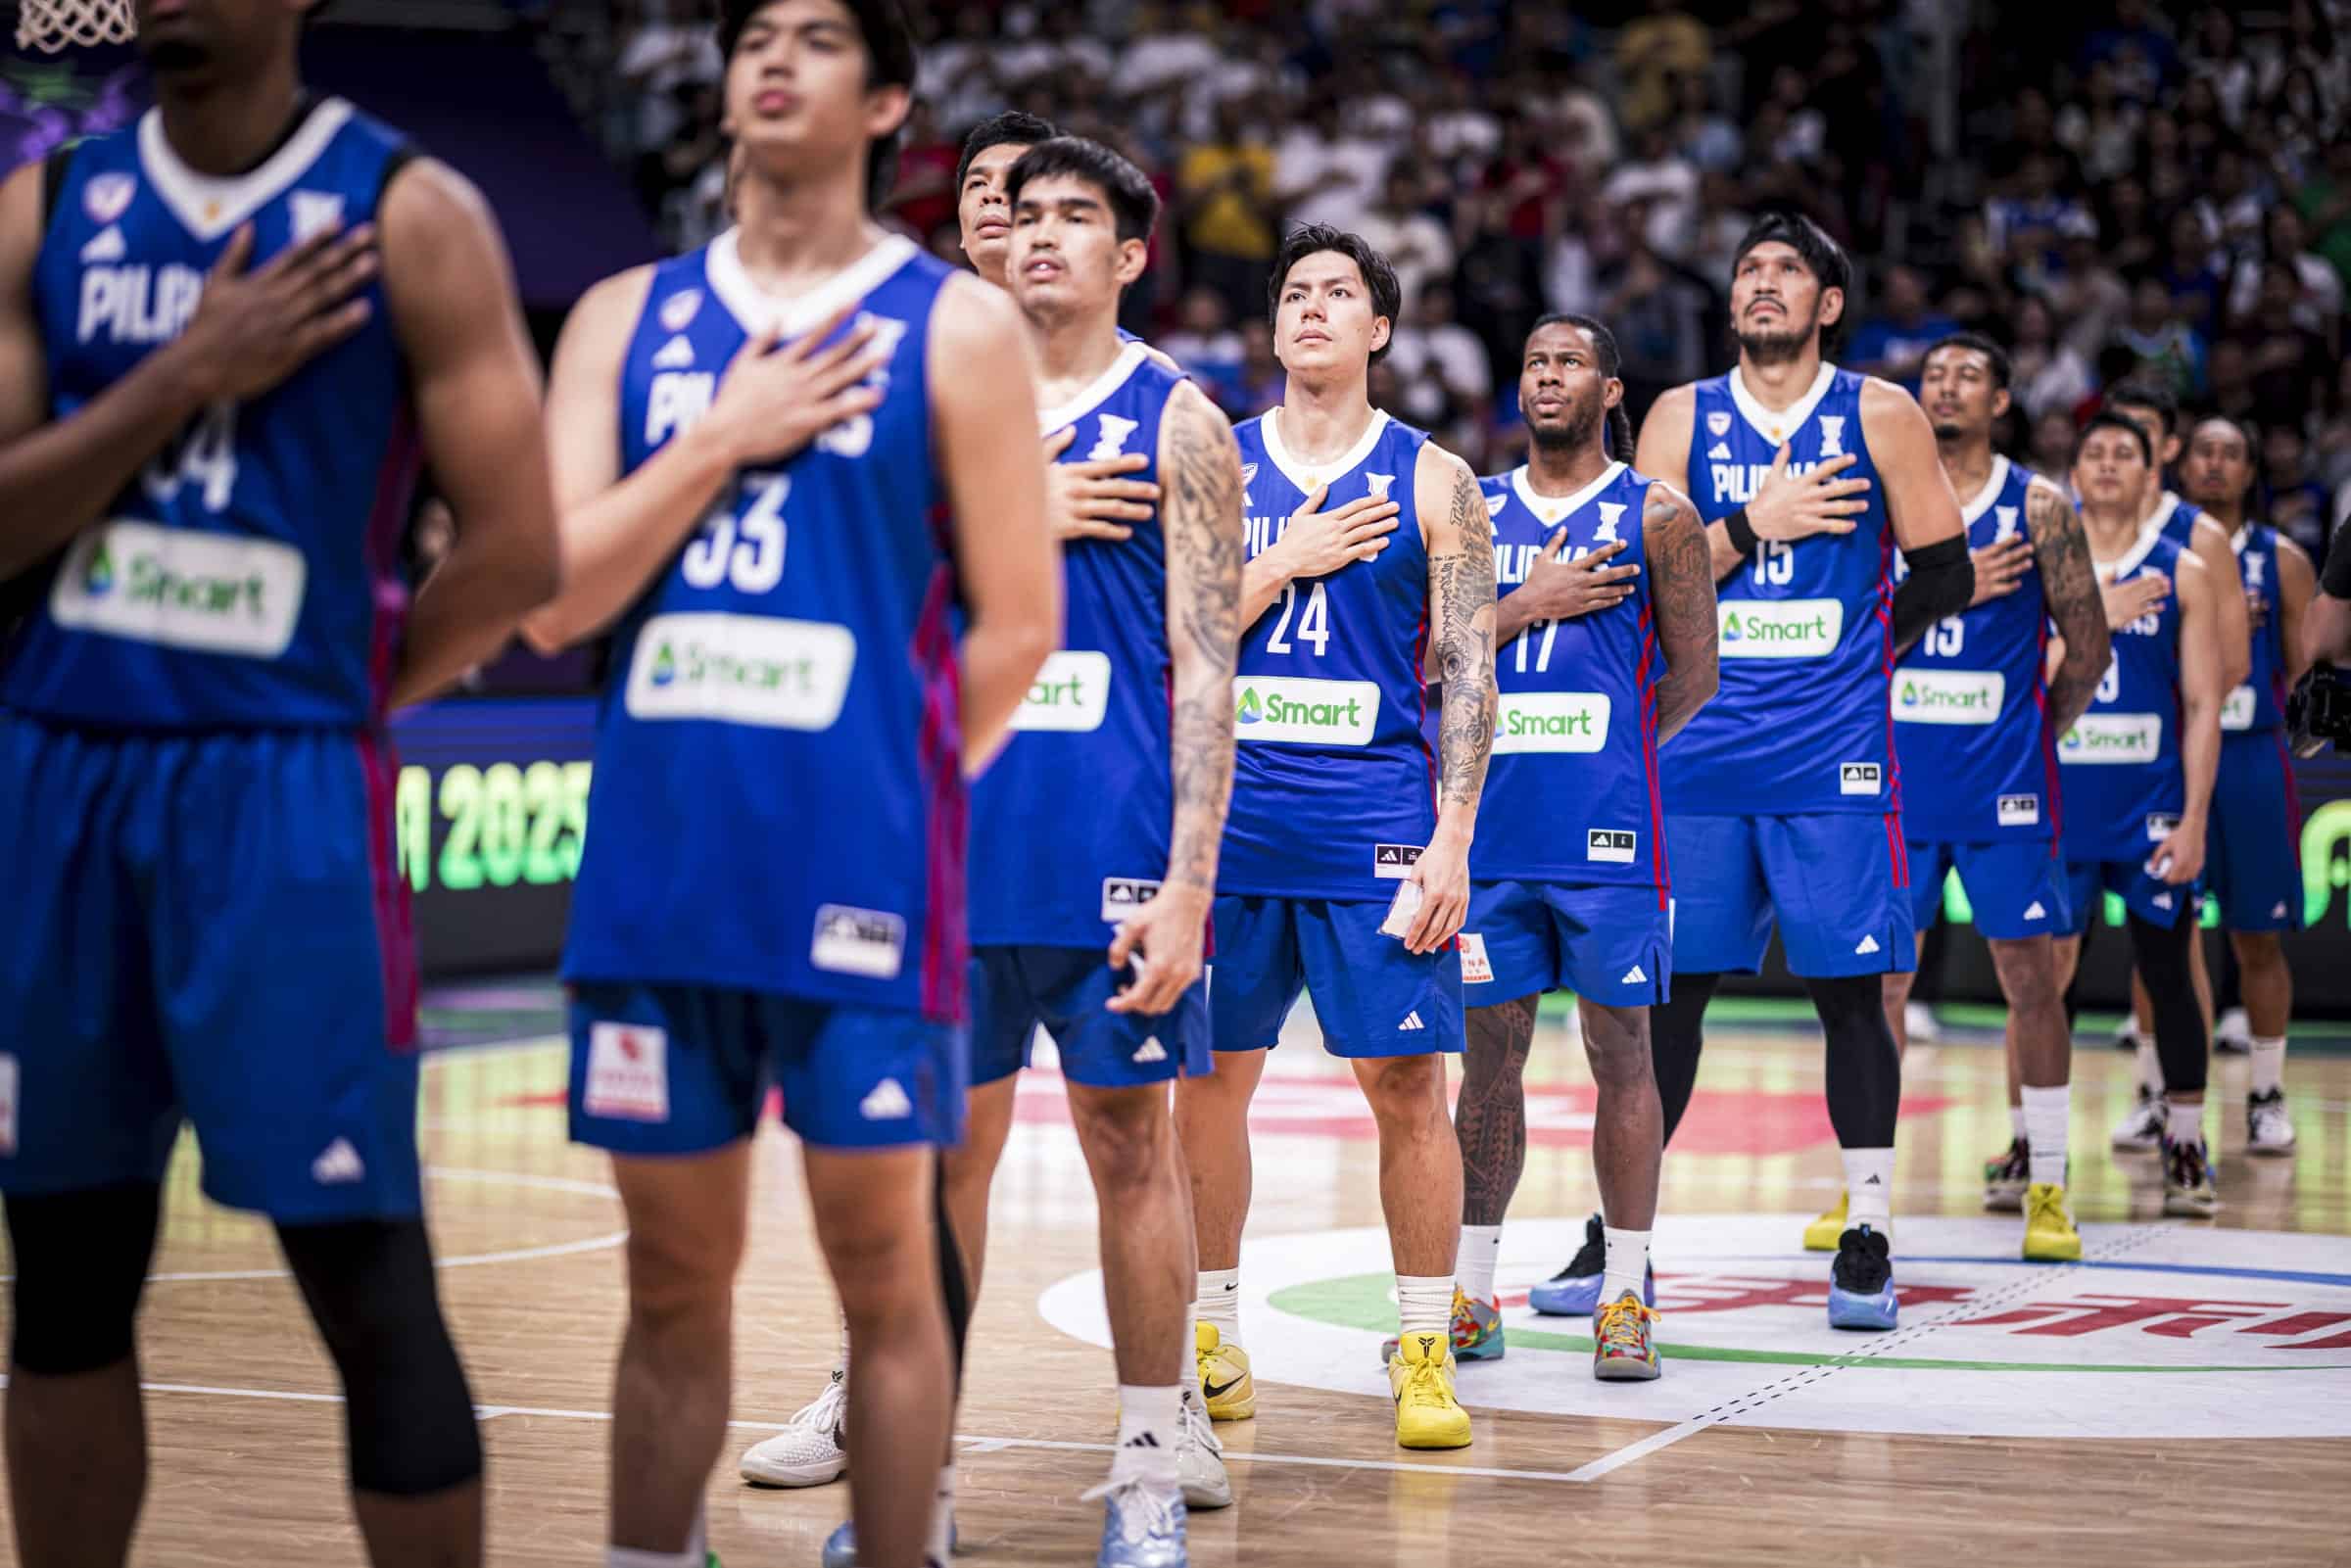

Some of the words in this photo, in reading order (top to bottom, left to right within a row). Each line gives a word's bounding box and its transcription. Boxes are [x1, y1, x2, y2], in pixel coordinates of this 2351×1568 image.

[1754, 540, 1794, 585] 15
[124, 550, 264, 622] Smart
[1267, 581, 1329, 656] 24
[1747, 615, 1826, 641] Smart
[687, 641, 813, 691] Smart
[1025, 674, 1084, 706] art
[1921, 686, 1989, 708] Smart
[1265, 692, 1363, 728] Smart
[1508, 709, 1592, 736] Smart
[2086, 729, 2147, 749] Smart
